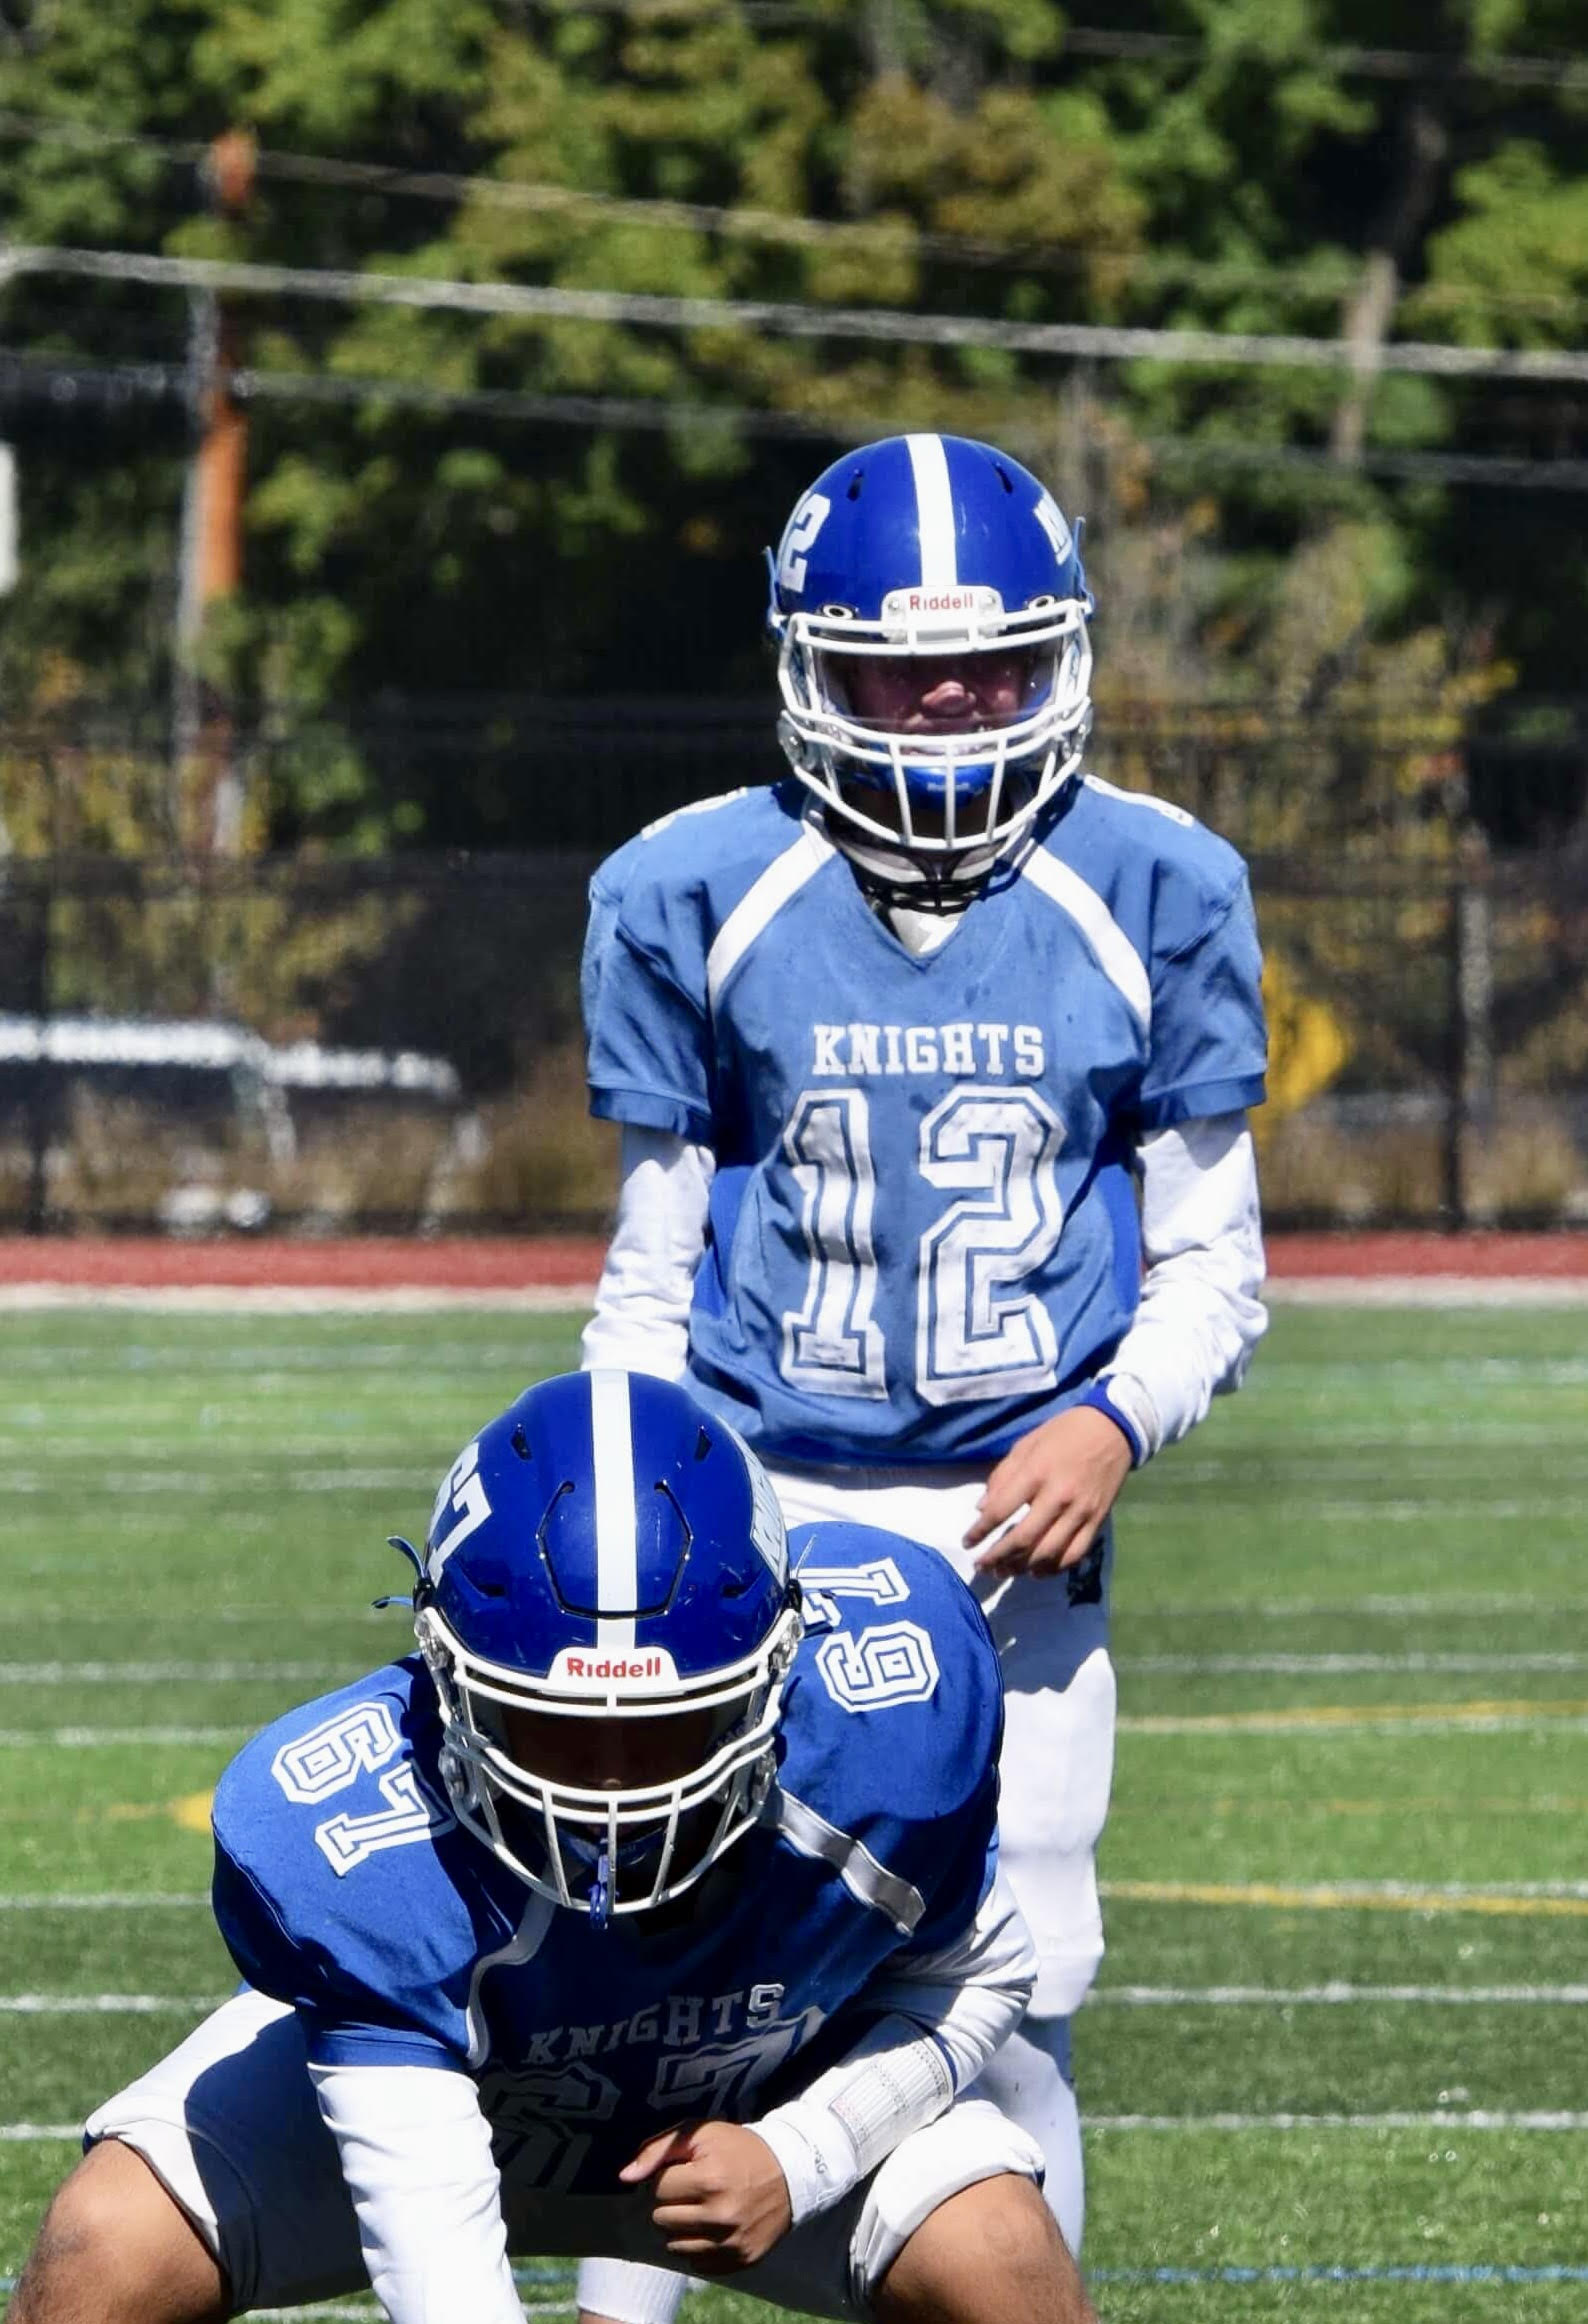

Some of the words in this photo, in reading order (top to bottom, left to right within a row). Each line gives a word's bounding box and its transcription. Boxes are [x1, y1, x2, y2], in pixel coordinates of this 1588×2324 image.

[909, 592, 974, 611] Riddell
[812, 1022, 1046, 1078] KNIGHTS
[780, 1084, 1067, 1408] 12
[566, 1656, 661, 1678] Riddell
[521, 1983, 785, 2065] KNIGHTS
